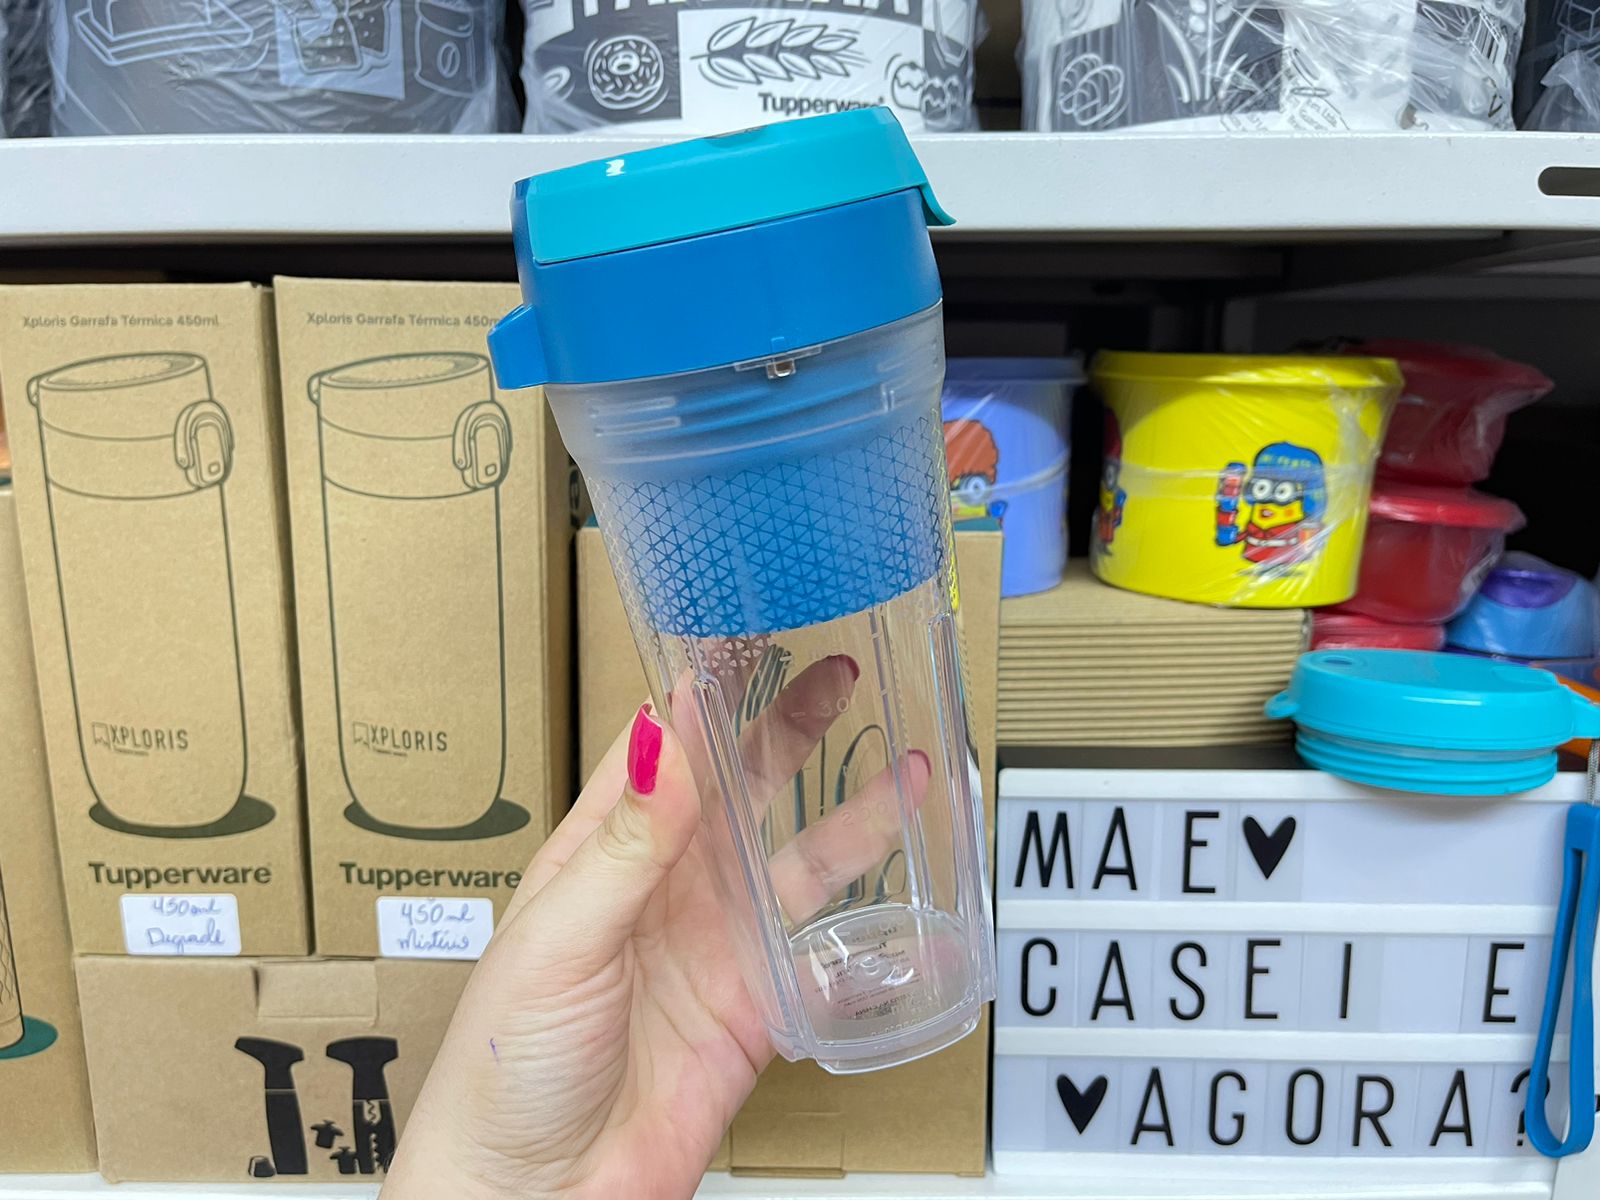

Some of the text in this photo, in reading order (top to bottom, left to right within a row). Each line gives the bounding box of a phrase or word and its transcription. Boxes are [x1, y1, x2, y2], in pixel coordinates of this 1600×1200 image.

[758, 92, 884, 116] Tupperwa
[23, 314, 219, 328] Xploris Garrafa Térmica 450ml
[306, 313, 500, 328] Xploris Garrafa Térmica 450m
[88, 862, 272, 889] Tupperware
[339, 862, 521, 890] Tupperware
[1020, 937, 1352, 1021] CASEI
[1482, 942, 1525, 1023] E
